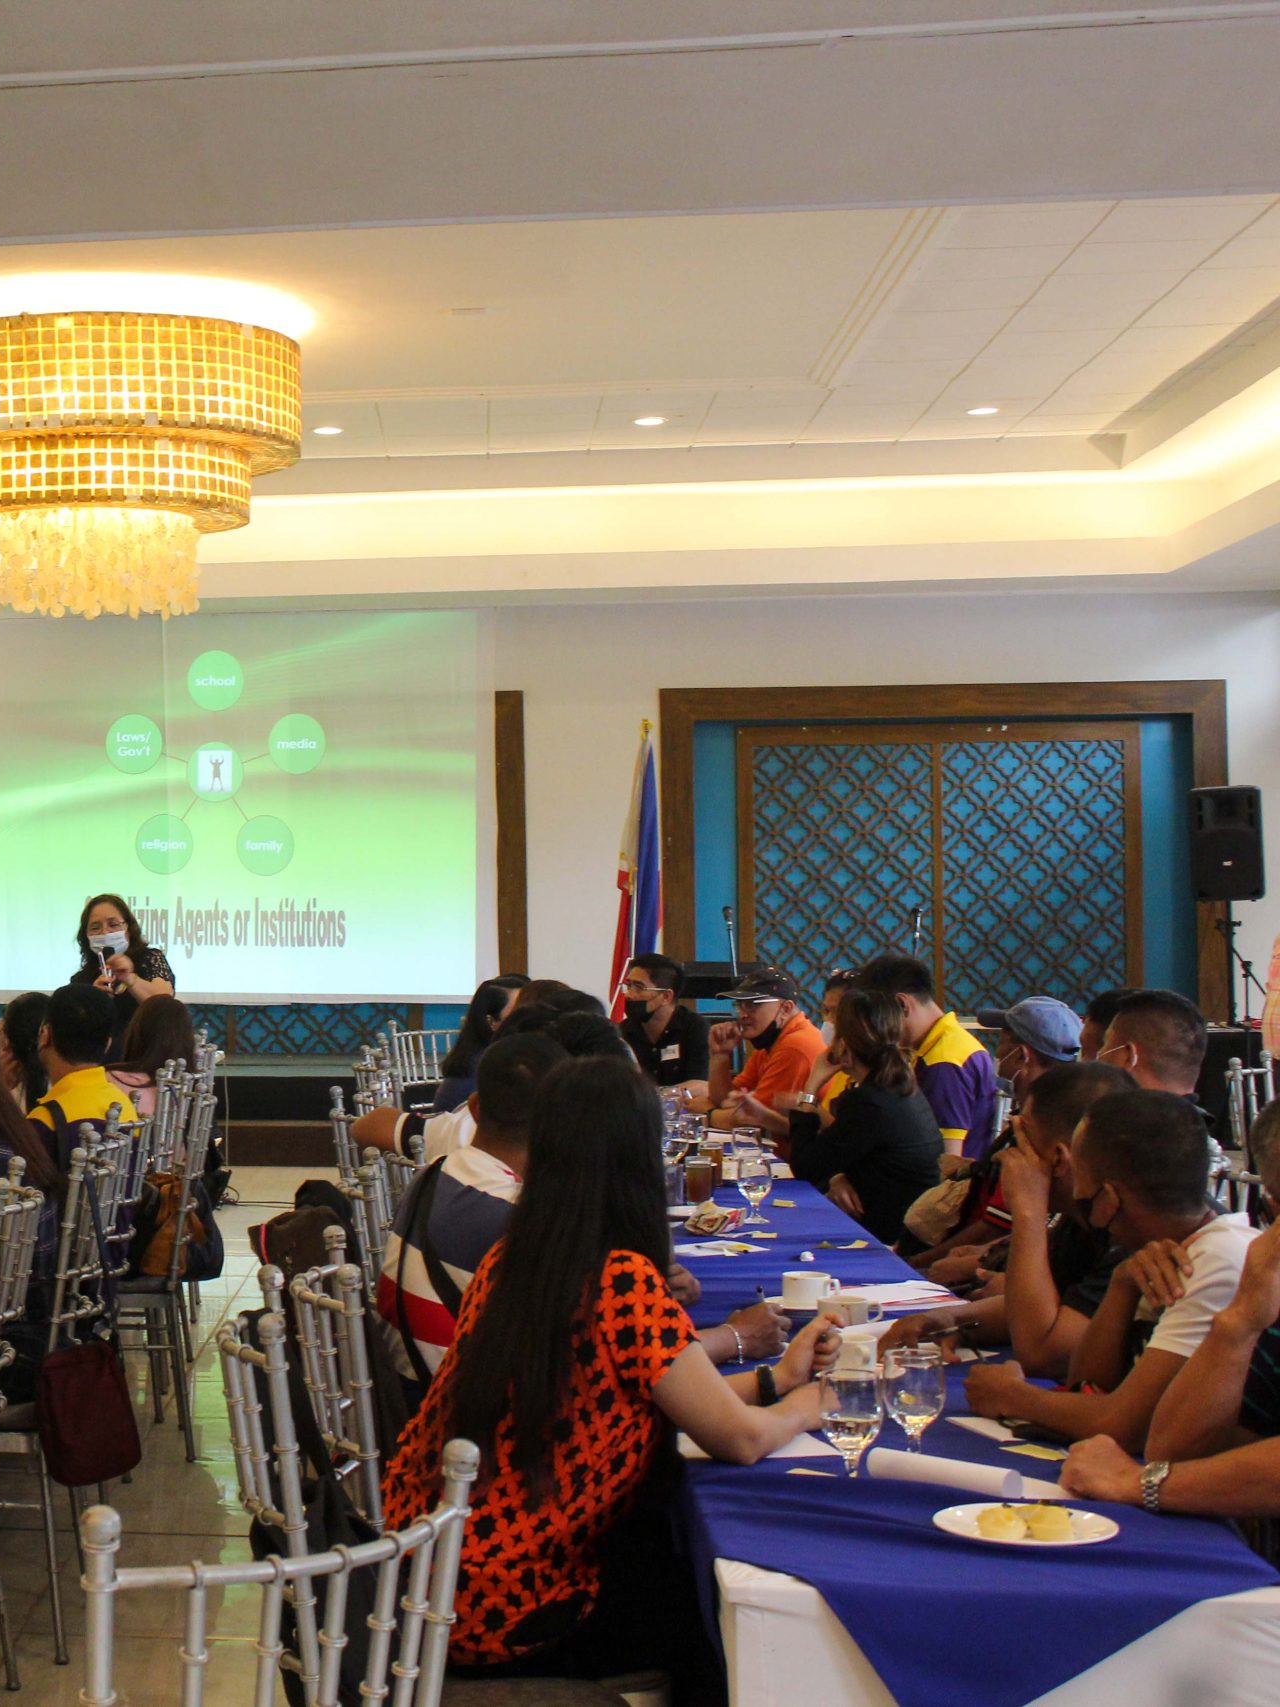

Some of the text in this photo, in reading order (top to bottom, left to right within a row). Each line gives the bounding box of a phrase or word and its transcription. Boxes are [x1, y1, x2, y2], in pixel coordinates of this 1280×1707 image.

[195, 676, 235, 686] school
[276, 738, 317, 749] media
[141, 838, 187, 851] religion
[245, 840, 283, 853] family
[173, 896, 229, 959] Agents
[233, 909, 250, 946] or
[254, 897, 346, 948] Institutions
